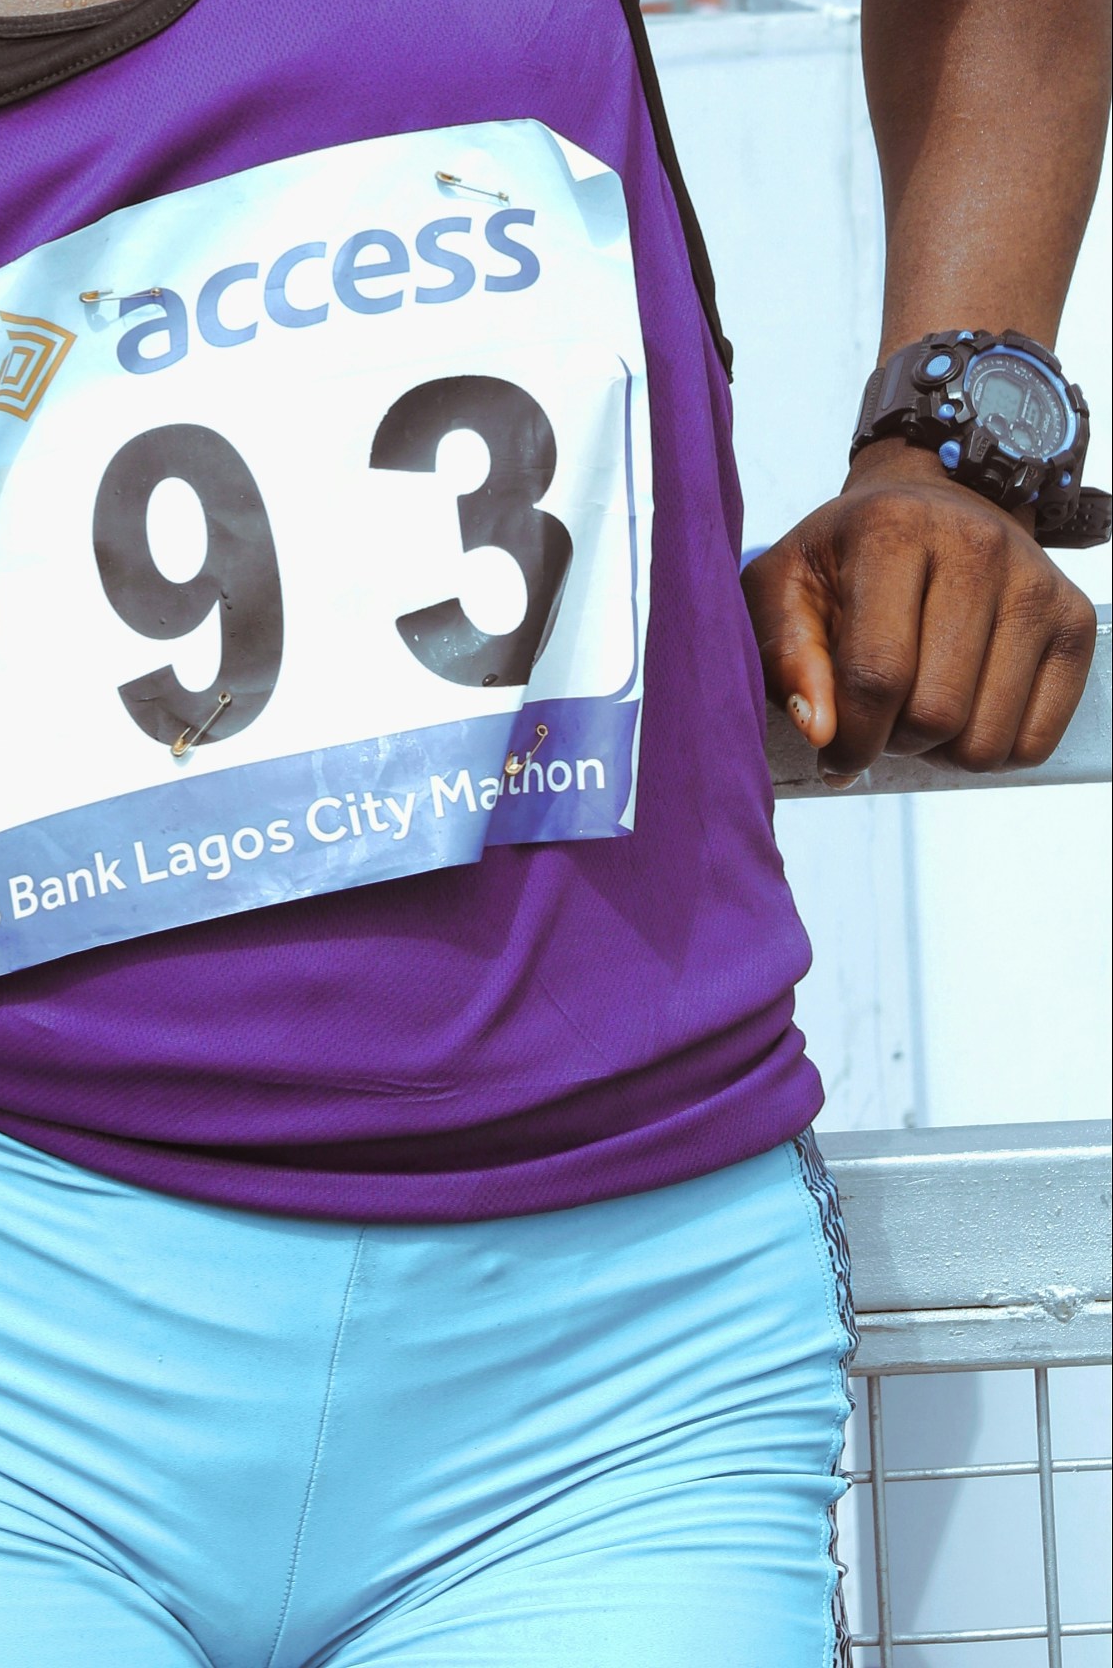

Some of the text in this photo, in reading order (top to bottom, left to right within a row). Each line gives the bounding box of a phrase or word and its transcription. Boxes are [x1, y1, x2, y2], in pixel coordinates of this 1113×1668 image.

[116, 208, 541, 375] access
[8, 851, 127, 920] Bank
[133, 818, 291, 884] Lagos
[305, 789, 417, 840] City
[429, 751, 605, 819] Mathon
